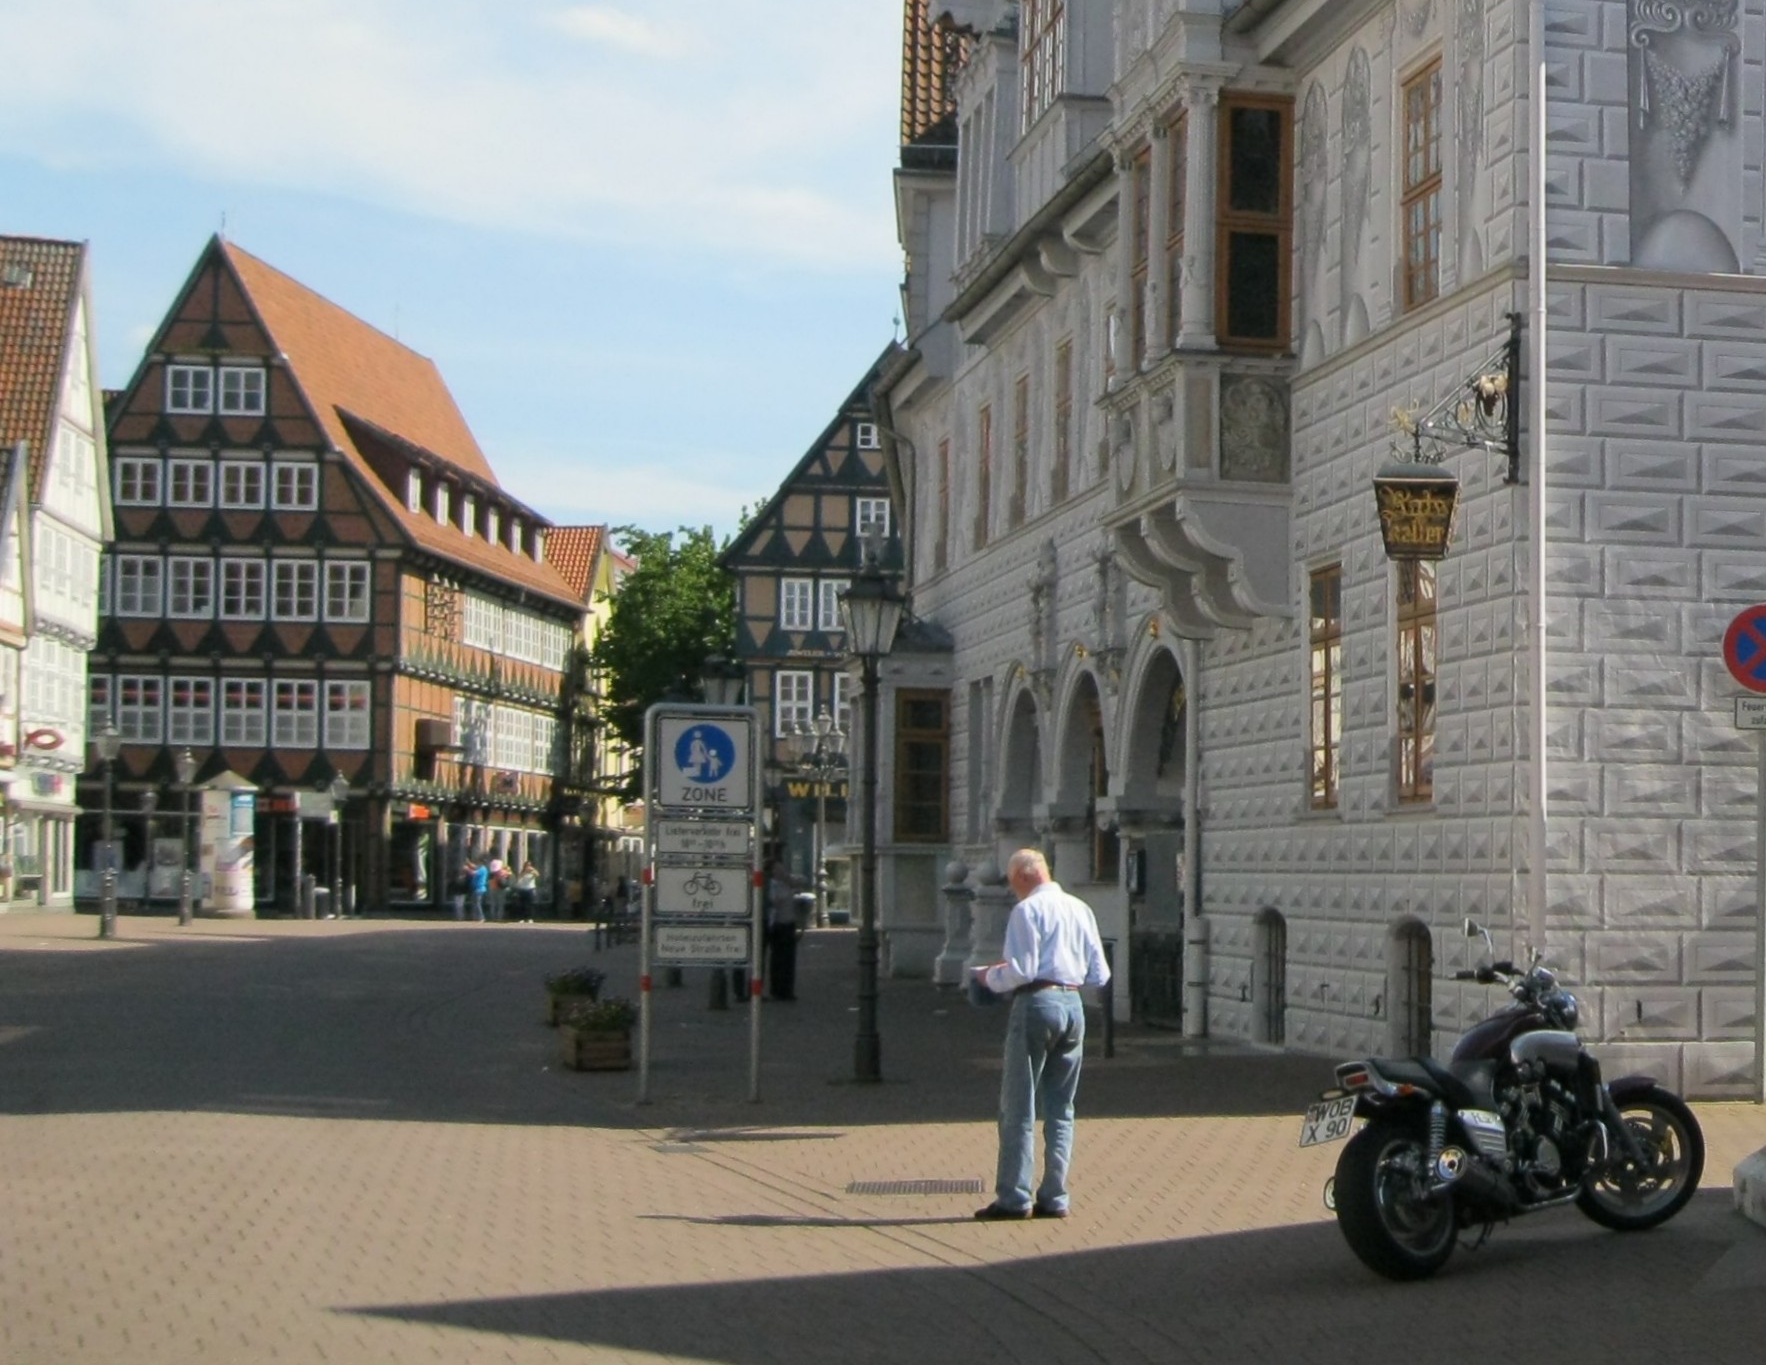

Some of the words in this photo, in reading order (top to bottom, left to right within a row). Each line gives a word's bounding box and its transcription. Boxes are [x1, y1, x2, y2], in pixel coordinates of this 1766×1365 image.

[681, 786, 728, 802] ZONE
[692, 898, 713, 908] frei
[1313, 1098, 1354, 1122] WOB
[1305, 1124, 1319, 1144] X
[1325, 1117, 1347, 1138] 90
